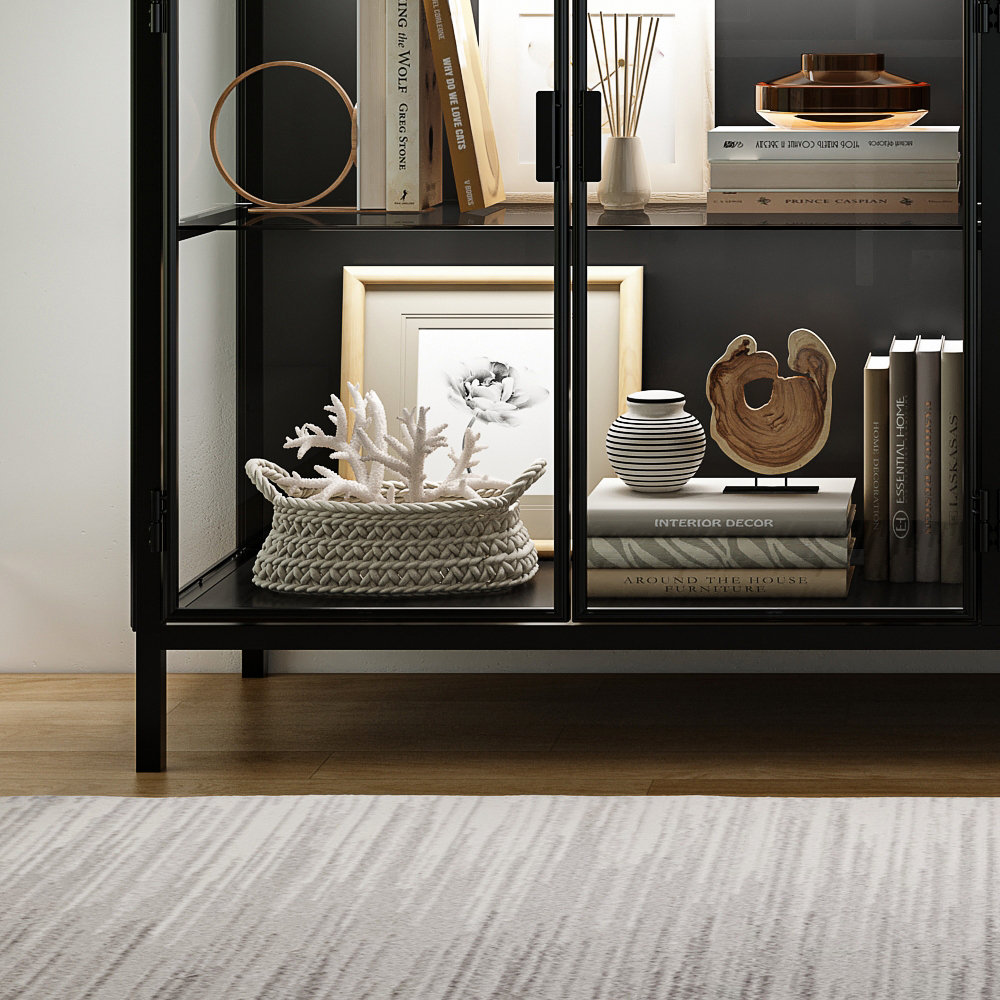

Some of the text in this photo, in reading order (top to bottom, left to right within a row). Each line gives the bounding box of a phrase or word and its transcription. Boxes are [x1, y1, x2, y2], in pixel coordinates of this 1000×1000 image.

[398, 32, 408, 48] the
[398, 50, 411, 94] WOLF
[442, 57, 467, 151] WHY DO WE LOVE CATS
[398, 103, 409, 171] GREG STONE
[896, 396, 905, 504] ESSENTIAL HOME
[948, 415, 959, 507] LASKASAS
[654, 518, 774, 528] INTERIOR DECOR
[623, 576, 808, 585] AROUND THE HOUSE
[665, 585, 767, 593] FURNITURE
